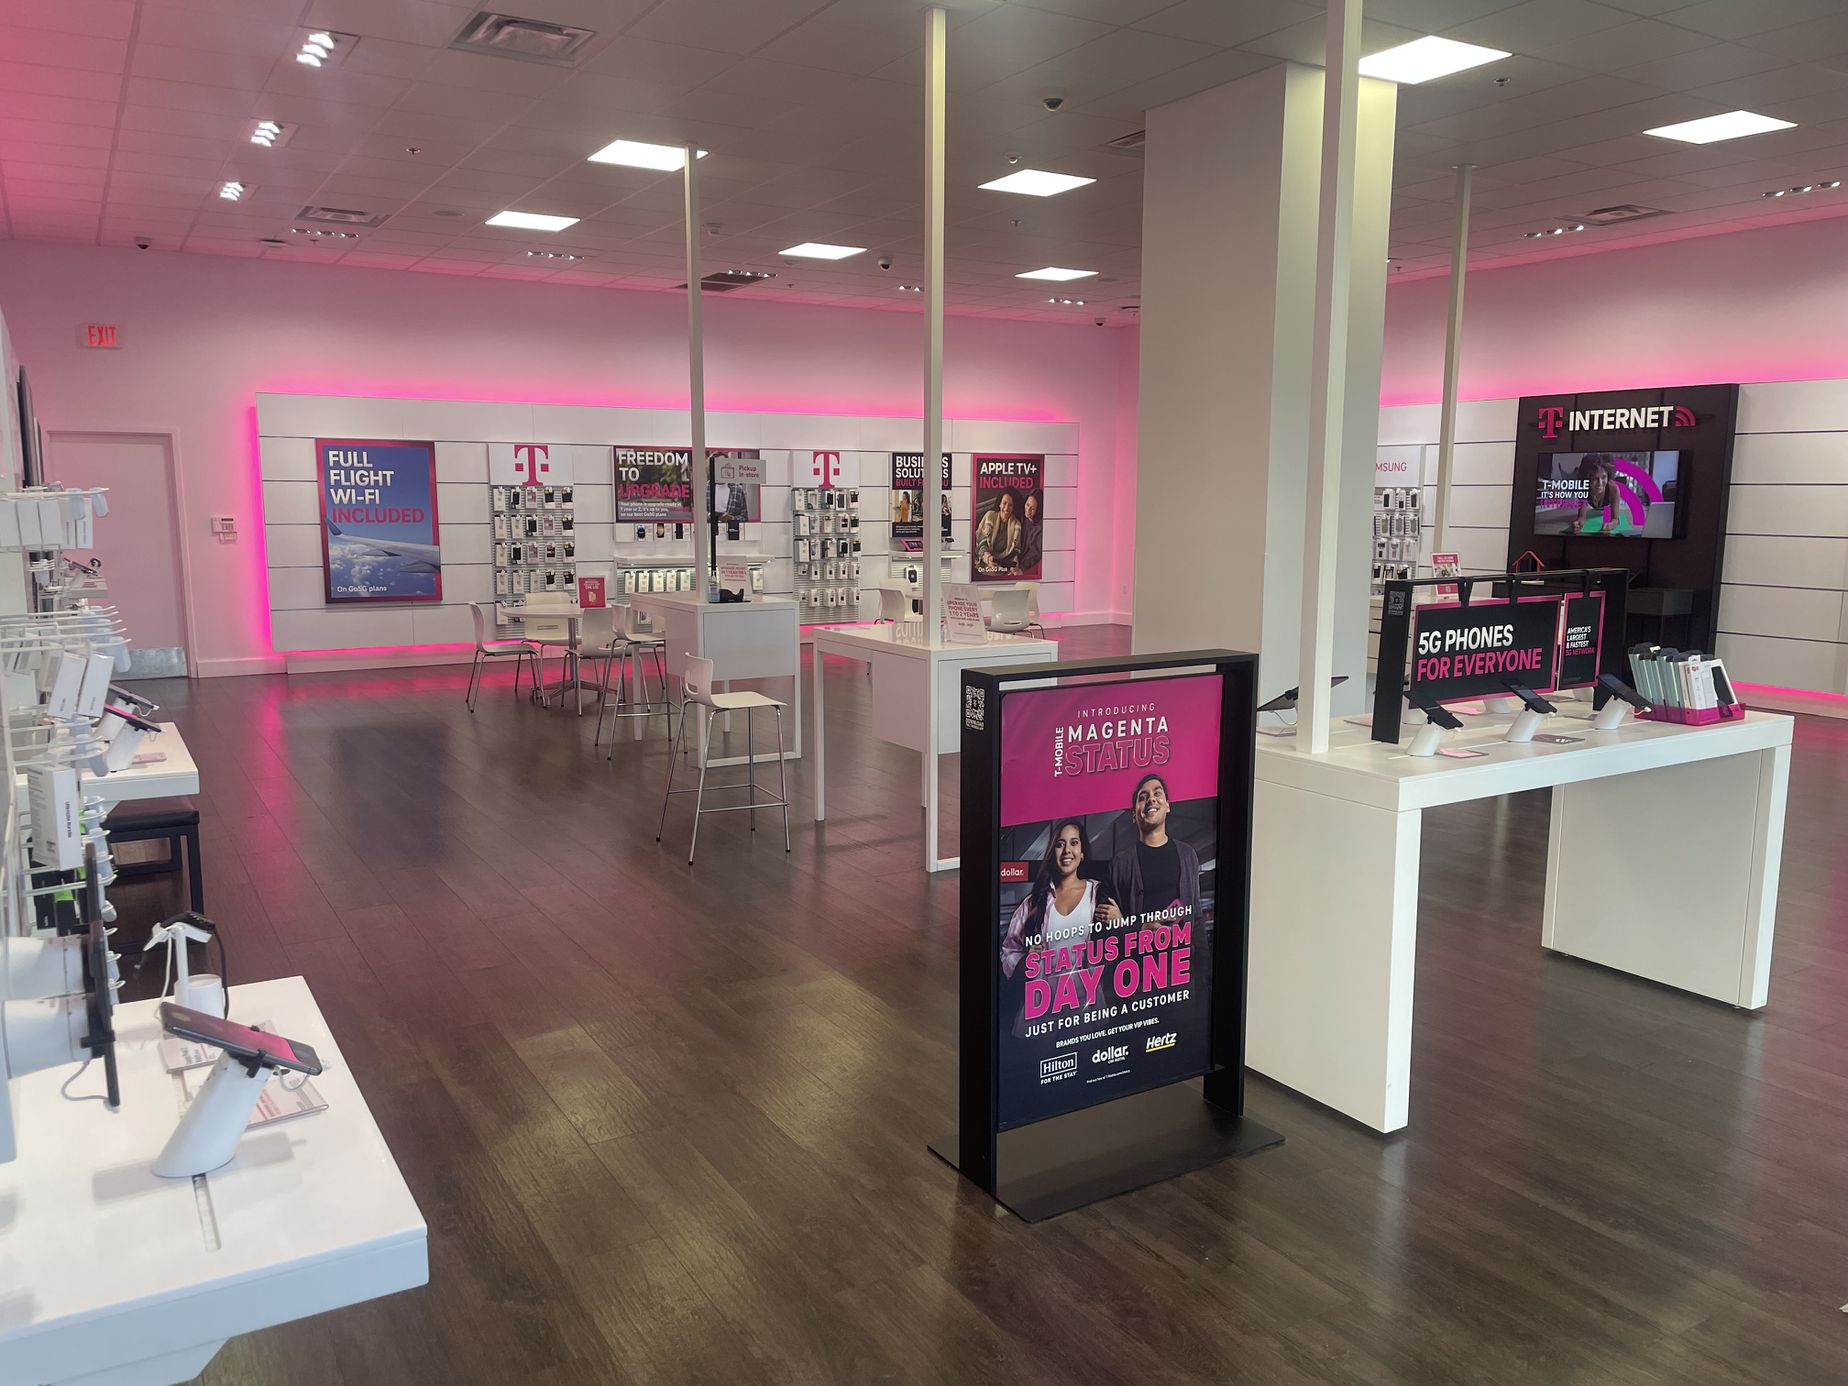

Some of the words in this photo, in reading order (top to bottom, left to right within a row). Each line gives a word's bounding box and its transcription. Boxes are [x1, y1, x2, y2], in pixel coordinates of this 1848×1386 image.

[88, 325, 117, 346] EXIT
[1568, 406, 1674, 431] INTERNET
[328, 450, 373, 467] FULL
[618, 451, 688, 466] FREEDOM
[1375, 462, 1407, 472] MSUNG
[619, 467, 640, 481] TO
[980, 462, 1015, 475] APPLE
[1016, 462, 1037, 475] TV+
[329, 470, 394, 487] FLIGHT
[895, 479, 916, 487] BUILT
[979, 476, 1034, 489] INCLUDED
[1542, 479, 1590, 490] T-MOBILE
[330, 488, 380, 505] WI-FI
[619, 483, 690, 498] UPGRADE
[1541, 491, 1554, 499] IT'S
[1554, 491, 1572, 499] HOW
[1573, 491, 1589, 499] YOU
[332, 507, 424, 524] INCLUDED
[1566, 633, 1587, 642] LARGEST
[1567, 625, 1592, 634] AMERICA'S
[1418, 630, 1441, 655] 5G
[1445, 624, 1514, 652] PHONES
[1570, 640, 1590, 648] FASTEST
[1572, 647, 1595, 655] NETWORK
[1417, 656, 1451, 681] FOR
[1453, 648, 1542, 678] EVERYONE
[1077, 702, 1156, 718] INTRODUCING
[1067, 716, 1169, 743] MAGENTA
[1054, 727, 1064, 777] T-MOBILE
[1064, 733, 1171, 776] STATUS
[1025, 934, 1042, 947] NO
[1046, 925, 1085, 942] HOOPS
[1088, 922, 1103, 934] TO
[1106, 915, 1137, 930] JUMP
[1140, 904, 1193, 923] THROUGH
[1024, 936, 1119, 978] STATUS
[1124, 921, 1192, 957] FROM
[1024, 965, 1106, 1020] DAY
[1113, 947, 1191, 998] ONE
[1025, 1021, 1055, 1038] JUST
[1058, 1015, 1080, 1030] FOR
[1084, 1006, 1118, 1024] BEING
[1121, 1003, 1129, 1015] A
[1131, 989, 1190, 1012] CUSTOMER
[1056, 1036, 1079, 1048] BRANDS
[1079, 1032, 1092, 1043] YOU
[1091, 1028, 1107, 1040] LOVE.
[1107, 1026, 1119, 1036] GET
[1119, 1023, 1134, 1033] YOUR
[1133, 1019, 1143, 1029] VIP
[1142, 1017, 1160, 1027] VIBES.
[1146, 1032, 1177, 1049] Hertz
[1043, 1057, 1075, 1074] Hilton
[1040, 1077, 1052, 1085] FOR
[1052, 1074, 1063, 1082] THE
[1064, 1071, 1077, 1080] STAY
